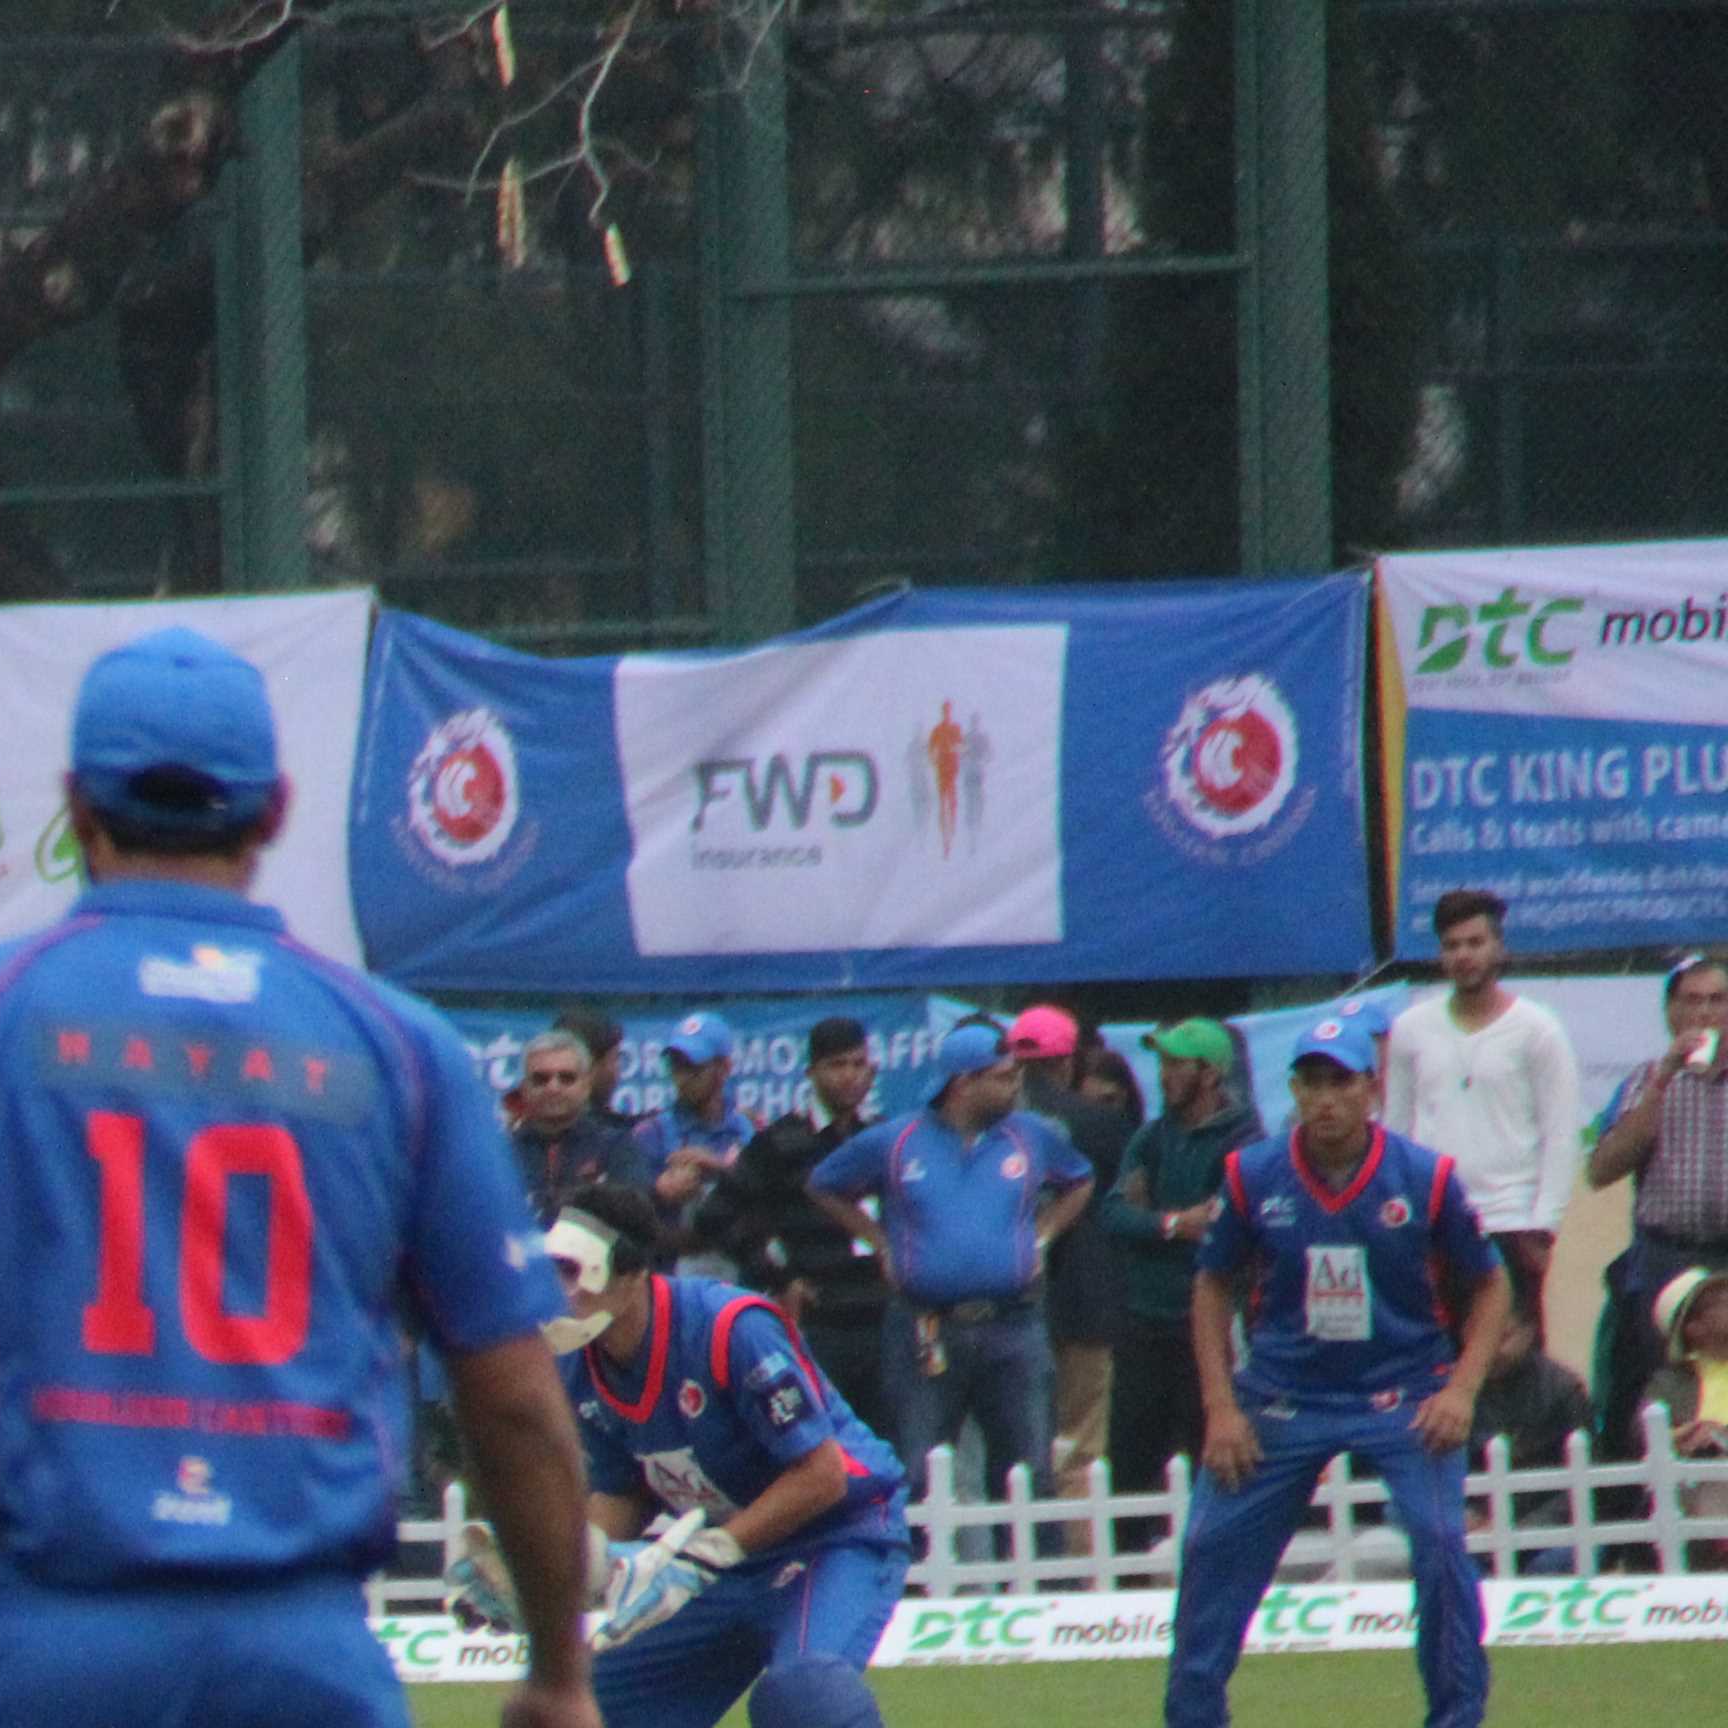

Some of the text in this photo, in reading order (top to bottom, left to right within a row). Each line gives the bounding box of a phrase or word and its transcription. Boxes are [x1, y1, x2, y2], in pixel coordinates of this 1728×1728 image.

[1600, 592, 1728, 645] mobi
[689, 750, 879, 832] FWD
[1409, 746, 1728, 810] DTC KING PLU
[81, 1110, 314, 1367] 10
[1050, 1611, 1175, 1645] mobile
[1645, 1597, 1728, 1627] mob
[458, 1636, 529, 1667] mob
